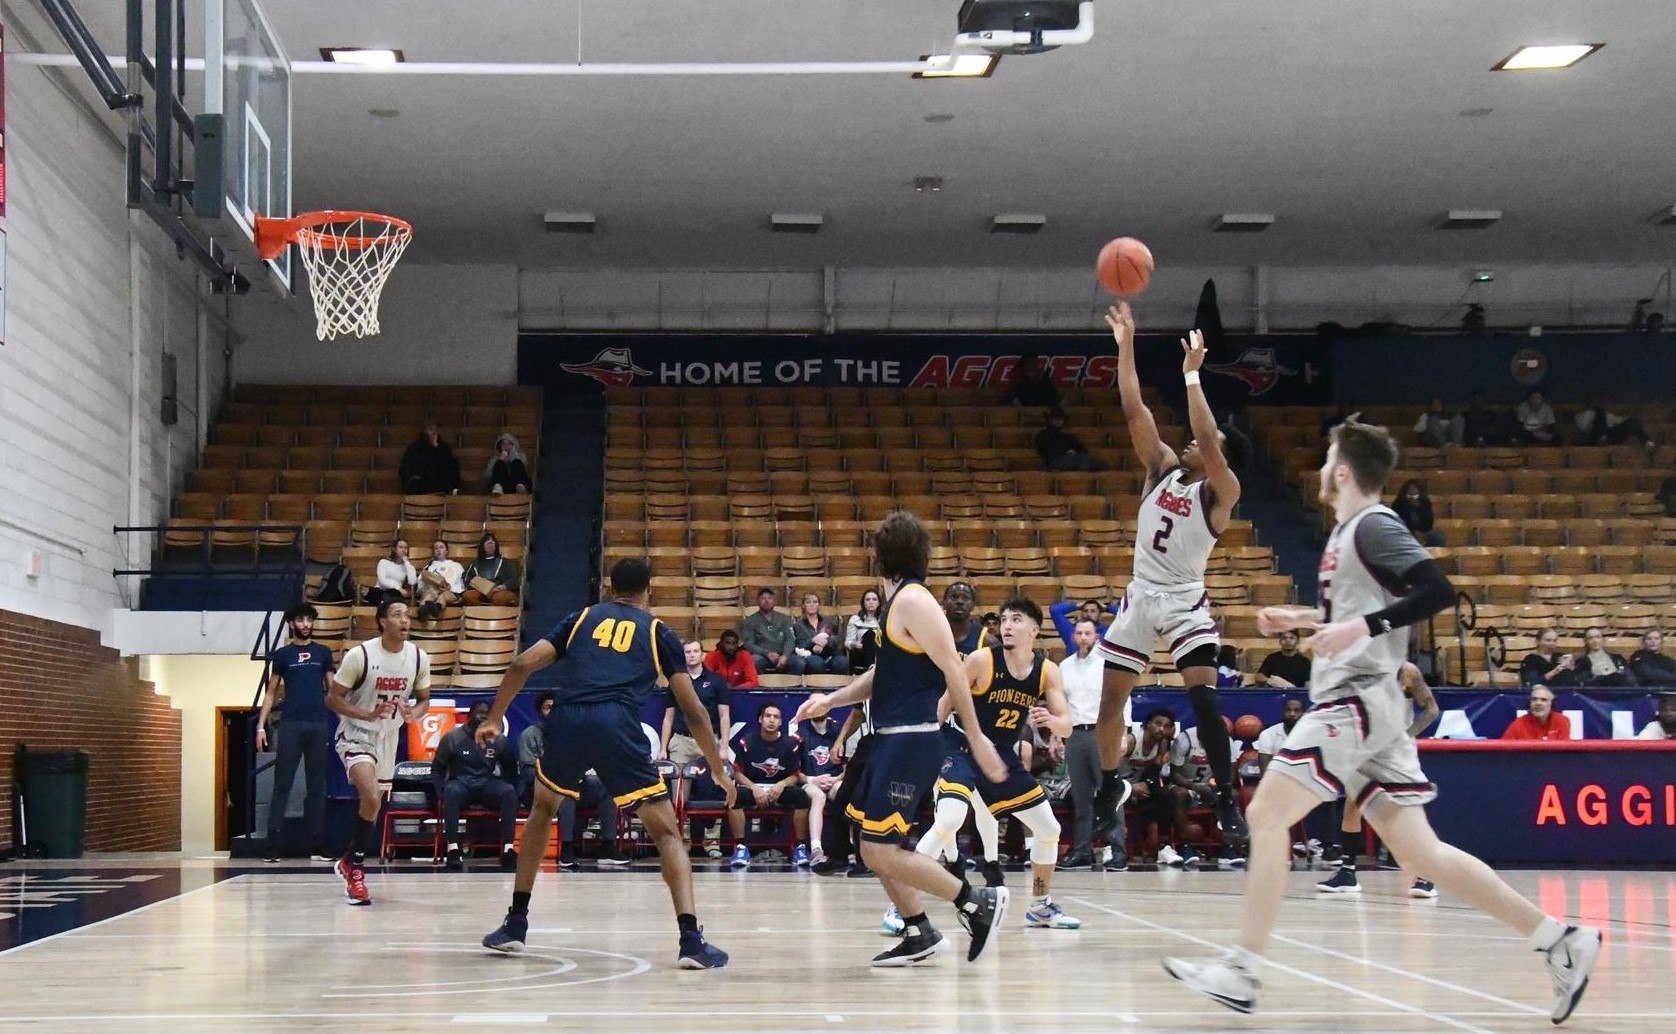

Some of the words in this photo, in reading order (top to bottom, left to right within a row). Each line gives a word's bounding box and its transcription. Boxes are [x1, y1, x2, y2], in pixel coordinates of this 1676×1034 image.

[660, 361, 762, 385] HOME
[774, 359, 823, 383] OF
[834, 358, 901, 383] THE
[908, 355, 1119, 388] AGGES
[1153, 515, 1173, 554] 2
[592, 618, 636, 653] 40
[375, 676, 408, 691] AGGIES
[422, 715, 438, 732] G
[995, 708, 1020, 729] 22
[1536, 784, 1676, 826] AGGI
